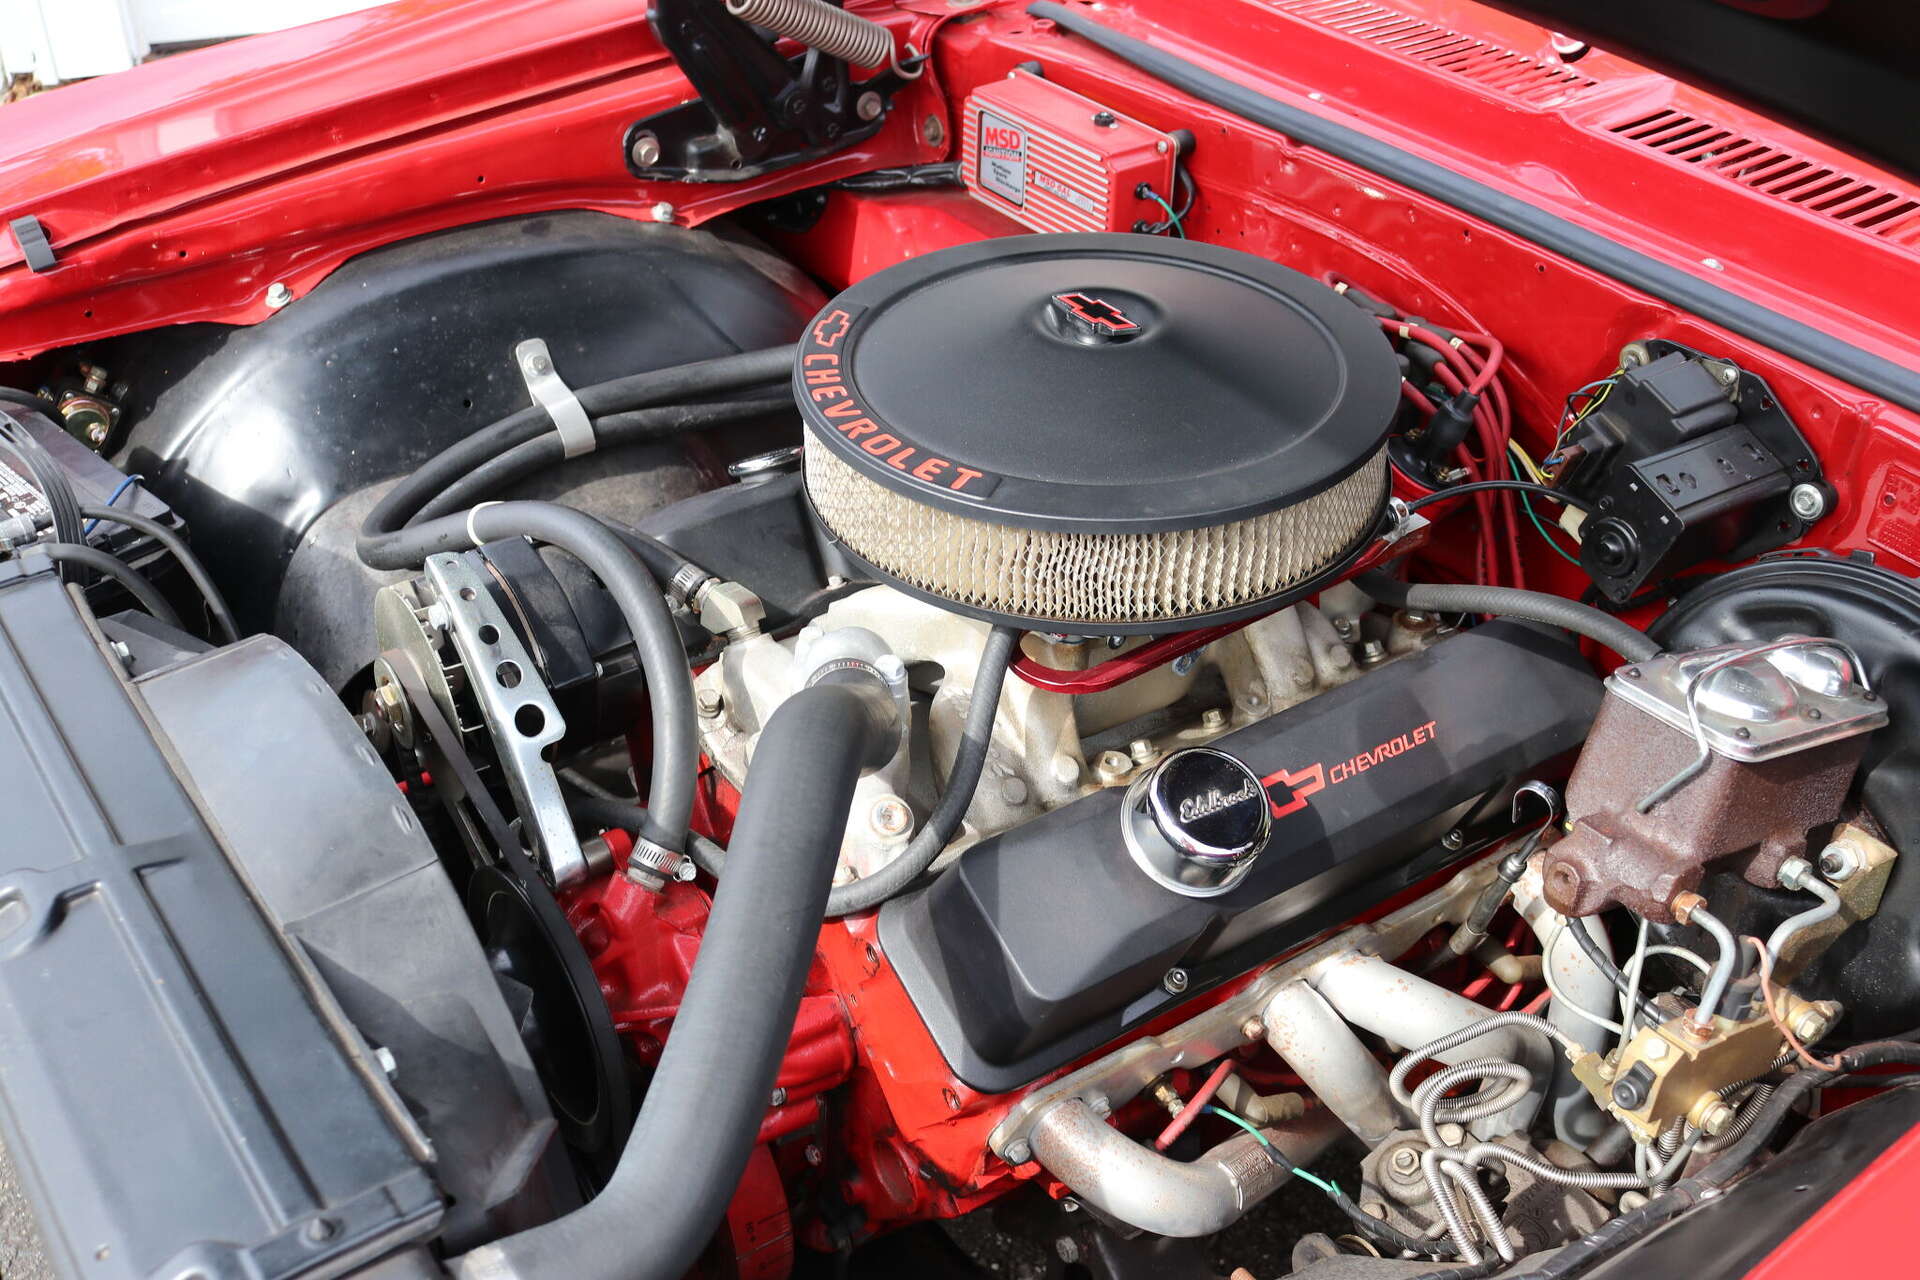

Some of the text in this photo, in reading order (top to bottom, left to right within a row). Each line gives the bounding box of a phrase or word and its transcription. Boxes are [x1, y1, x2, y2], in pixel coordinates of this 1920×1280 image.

[985, 127, 1020, 149] MSD
[803, 354, 983, 490] CHEVROLET
[1329, 721, 1437, 784] CHEVROLET
[1180, 778, 1257, 823] Edelbrock
